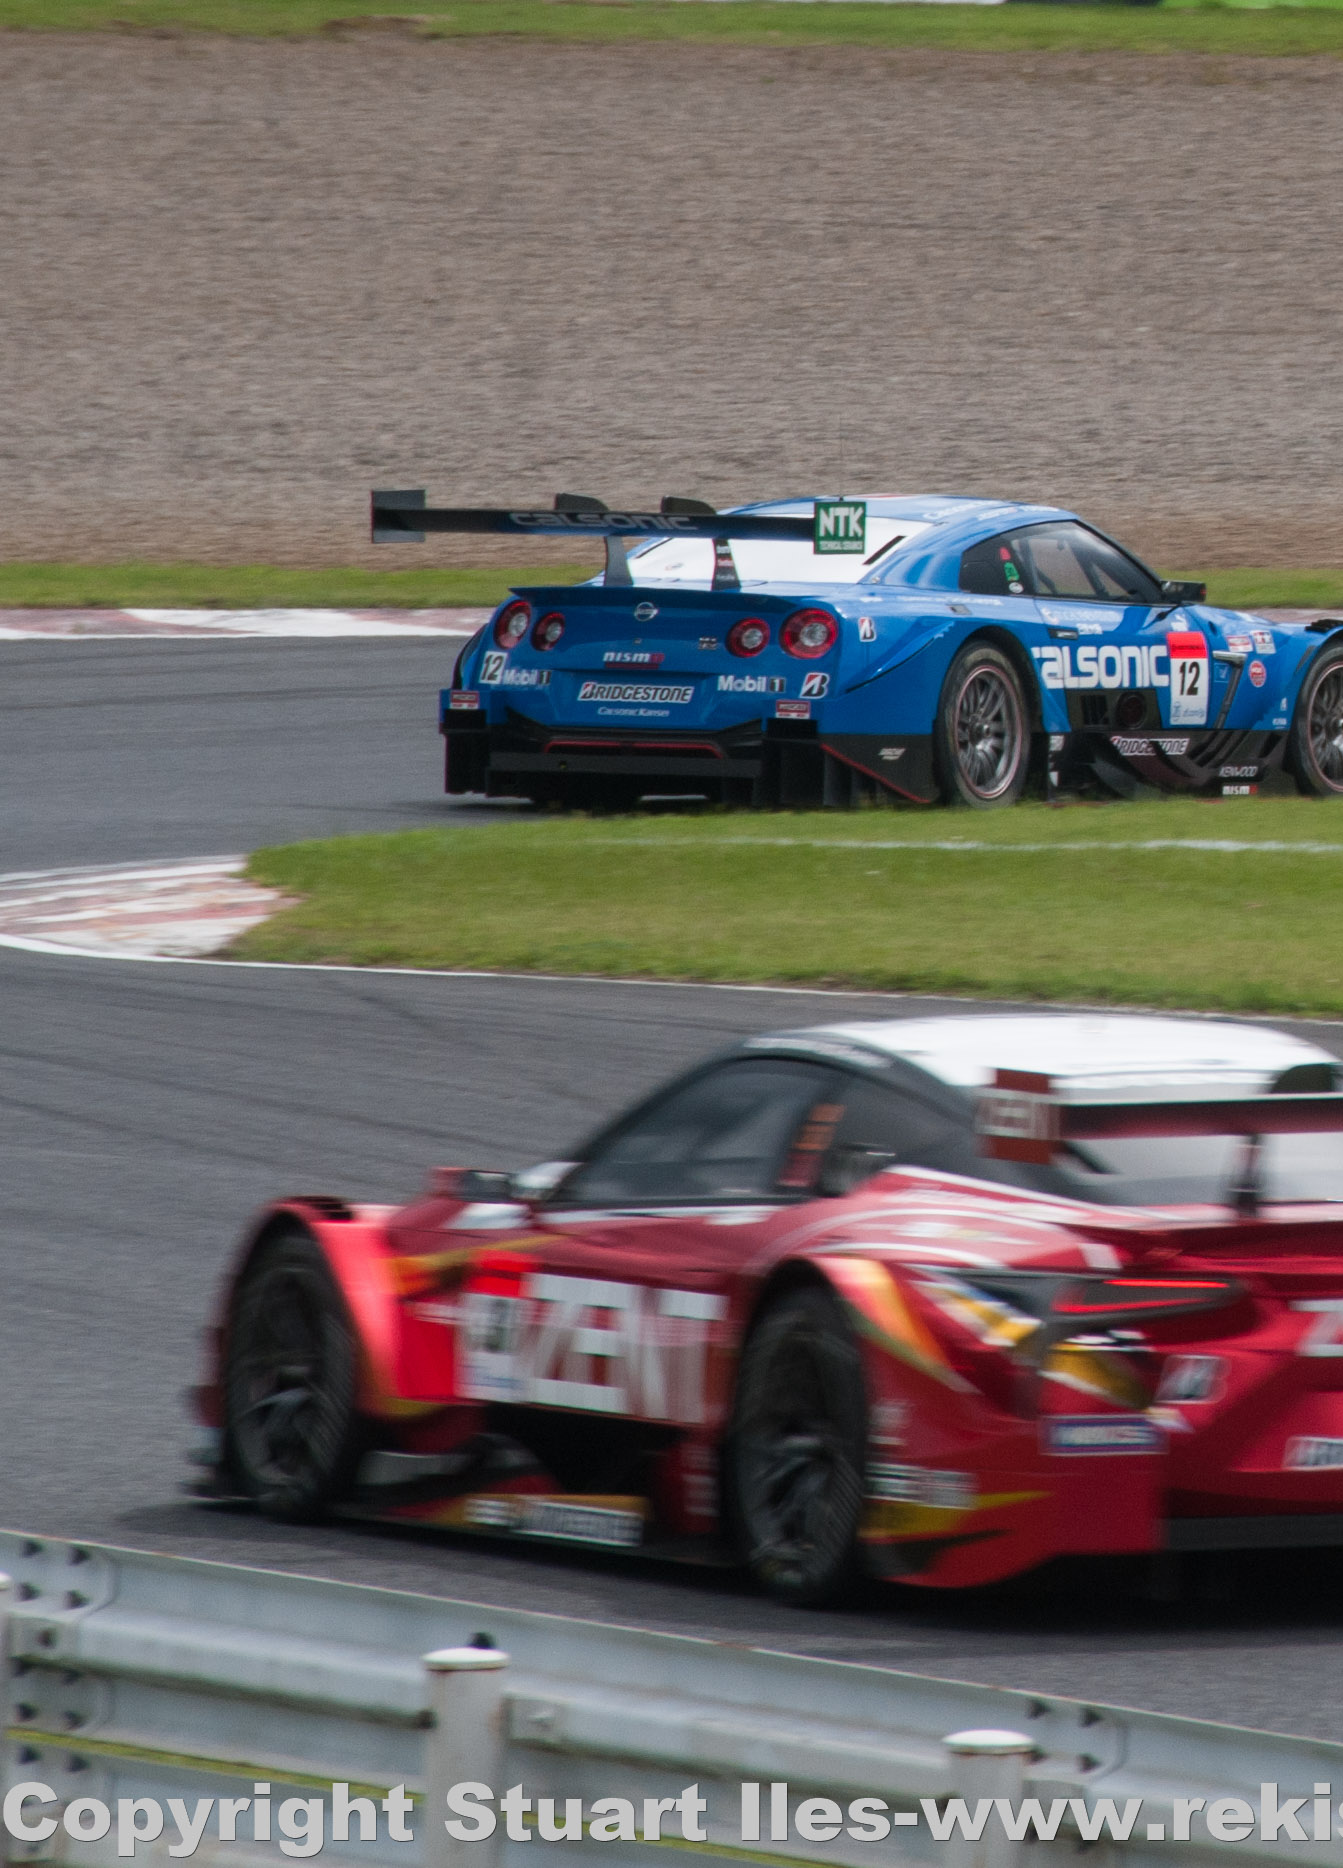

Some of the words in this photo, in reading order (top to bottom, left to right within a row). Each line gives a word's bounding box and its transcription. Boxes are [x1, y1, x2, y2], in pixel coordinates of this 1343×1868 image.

[819, 506, 864, 537] NTK
[481, 654, 503, 681] 12
[503, 669, 537, 685] Mobil
[718, 675, 766, 692] Mobil
[1179, 661, 1200, 696] 12
[579, 682, 694, 702] BRIDGESTONE
[1111, 736, 1189, 756] BRIDGETONE
